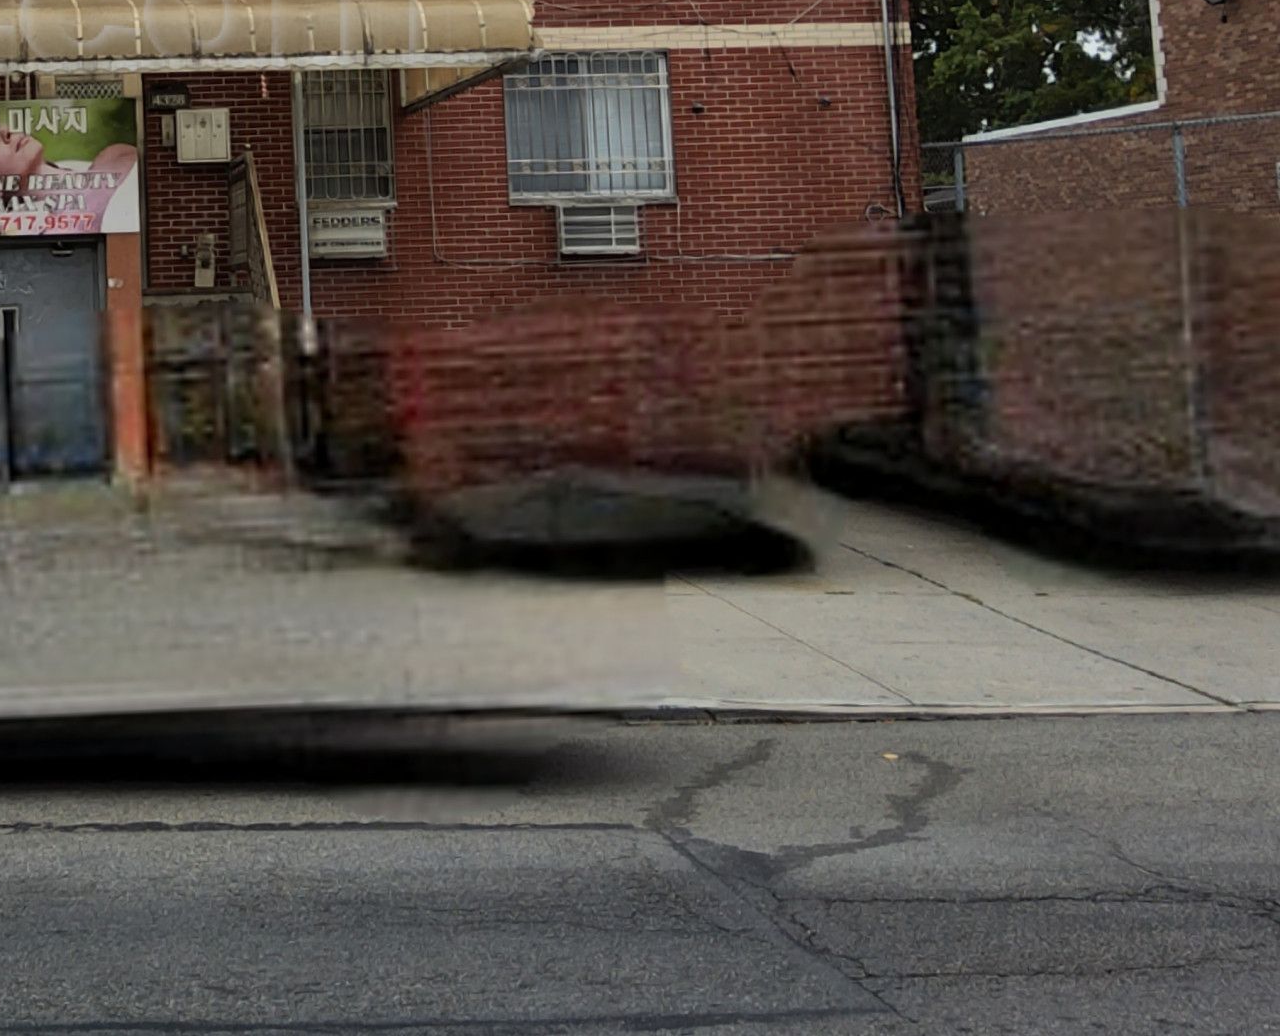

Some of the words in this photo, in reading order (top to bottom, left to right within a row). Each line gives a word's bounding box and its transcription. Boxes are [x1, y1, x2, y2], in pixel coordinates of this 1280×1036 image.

[8, 106, 88, 134] 마사지
[27, 172, 122, 191] BEAUTY
[43, 193, 87, 212] SPA
